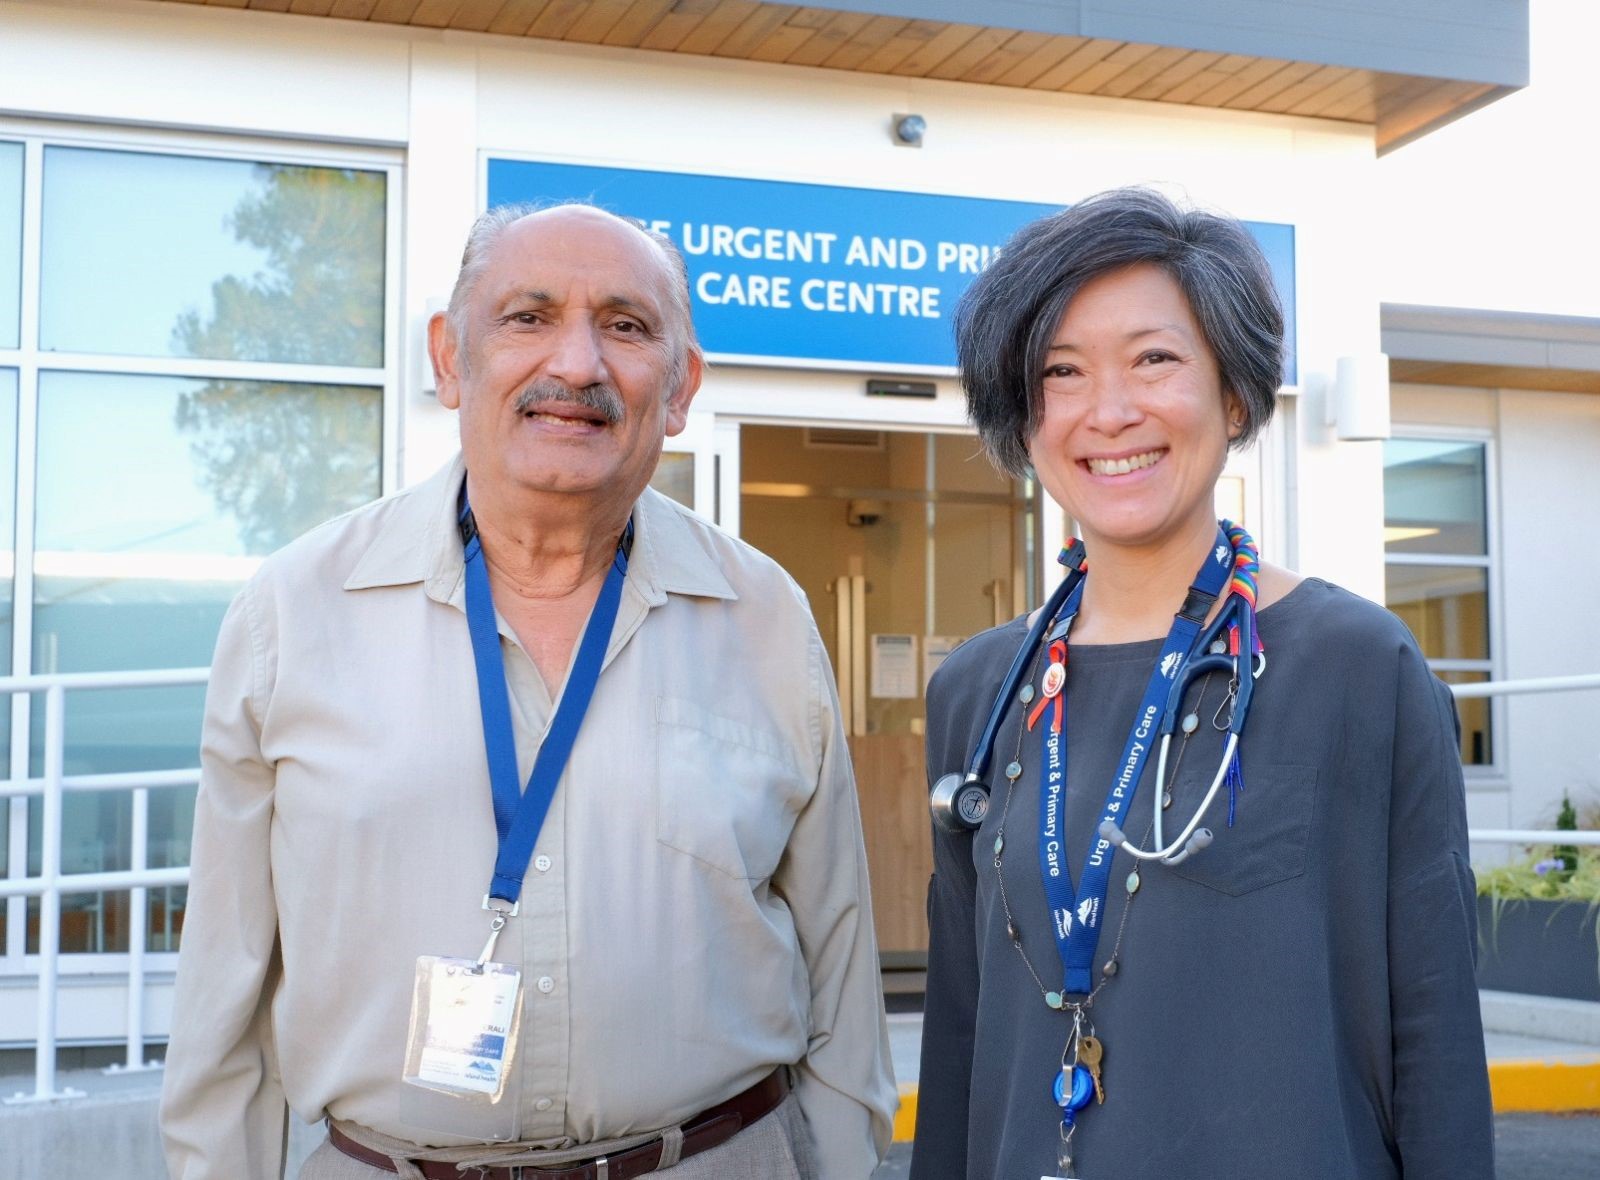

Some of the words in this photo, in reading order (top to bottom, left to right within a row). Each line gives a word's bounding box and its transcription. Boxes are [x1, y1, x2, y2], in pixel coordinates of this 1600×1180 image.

[682, 222, 838, 264] URGENT
[845, 235, 927, 271] AND
[697, 272, 792, 309] CARE
[800, 279, 941, 319] CENTRE
[1135, 705, 1157, 738] Care
[1047, 724, 1061, 769] rgent
[1048, 771, 1061, 783] &
[1113, 742, 1144, 798] Primary
[1044, 785, 1060, 837] Primary
[1107, 801, 1121, 813] &
[1046, 841, 1060, 877] Care
[1089, 816, 1116, 867] Urgt
